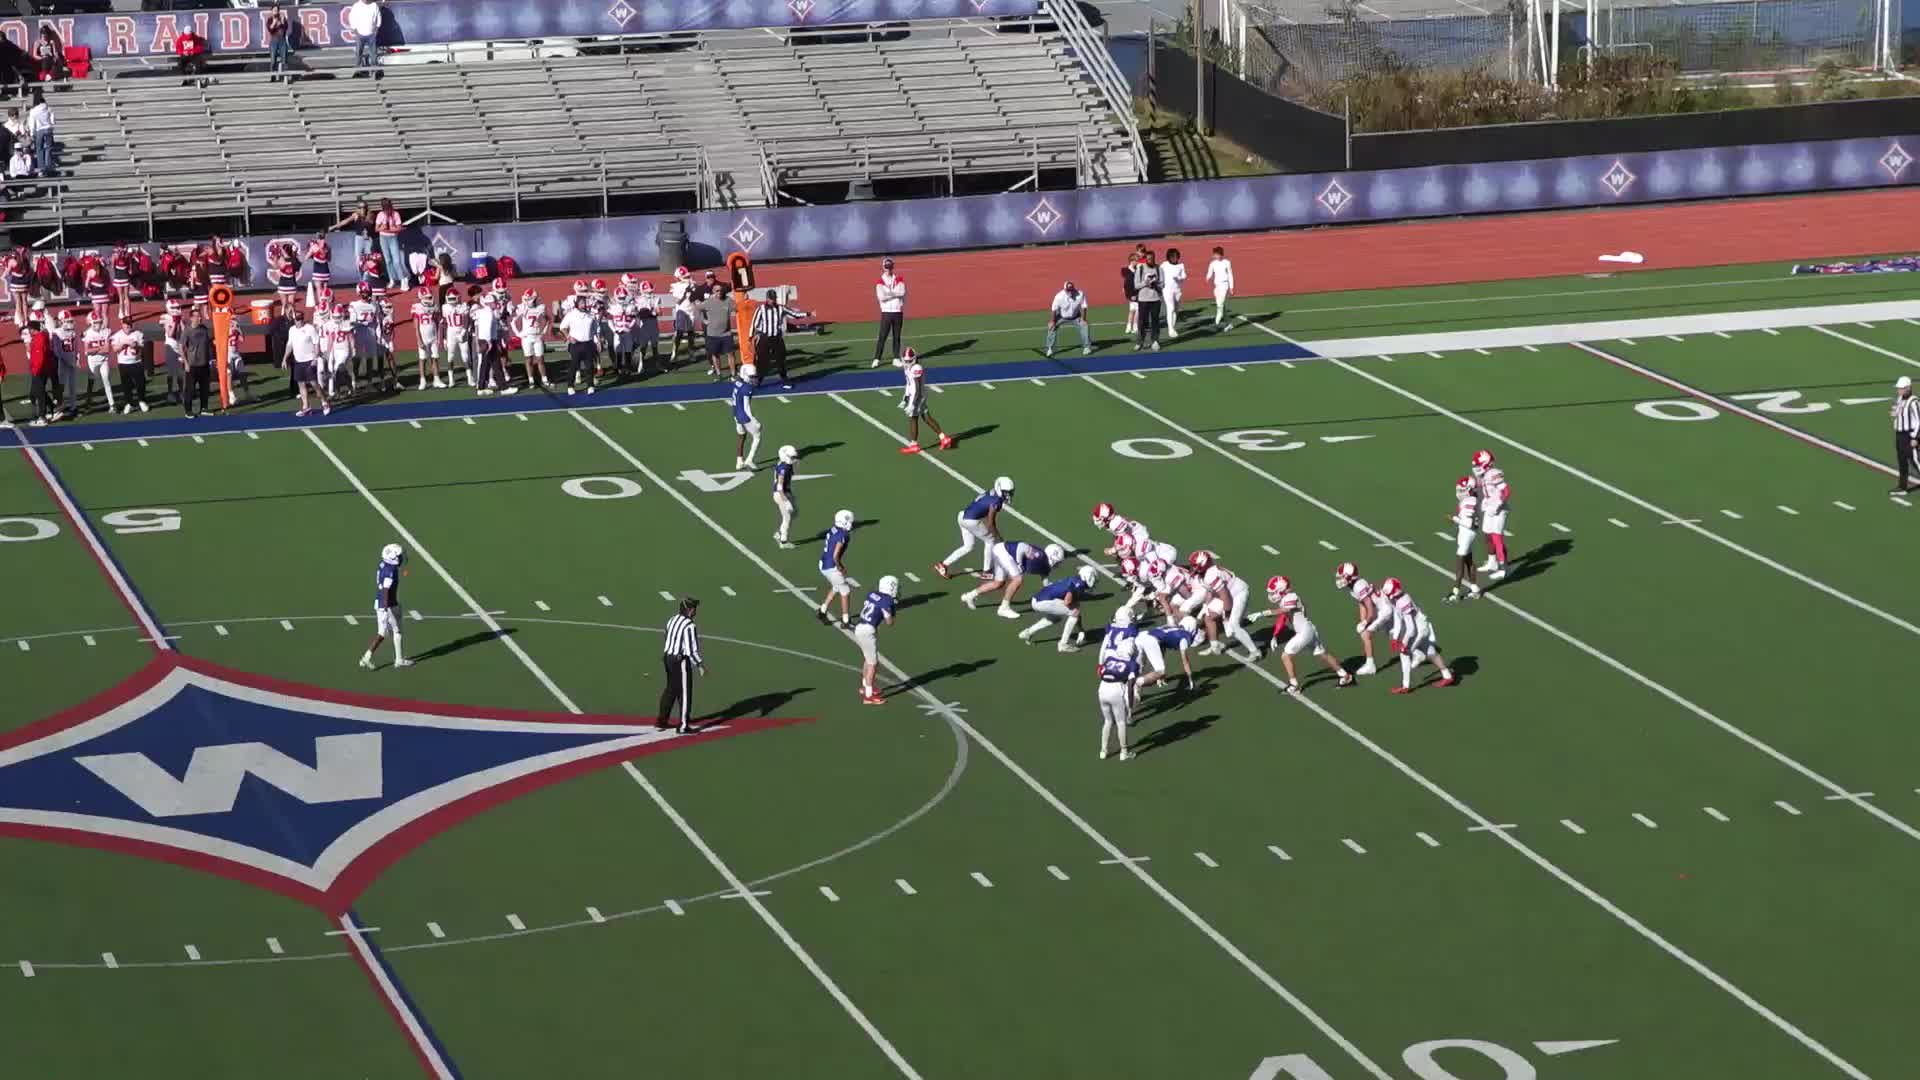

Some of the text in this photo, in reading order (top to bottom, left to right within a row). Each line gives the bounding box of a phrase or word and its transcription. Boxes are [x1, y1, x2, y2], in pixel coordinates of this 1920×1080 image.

[737, 267, 749, 286] 1
[527, 315, 538, 328] 7
[73, 732, 384, 818] W
